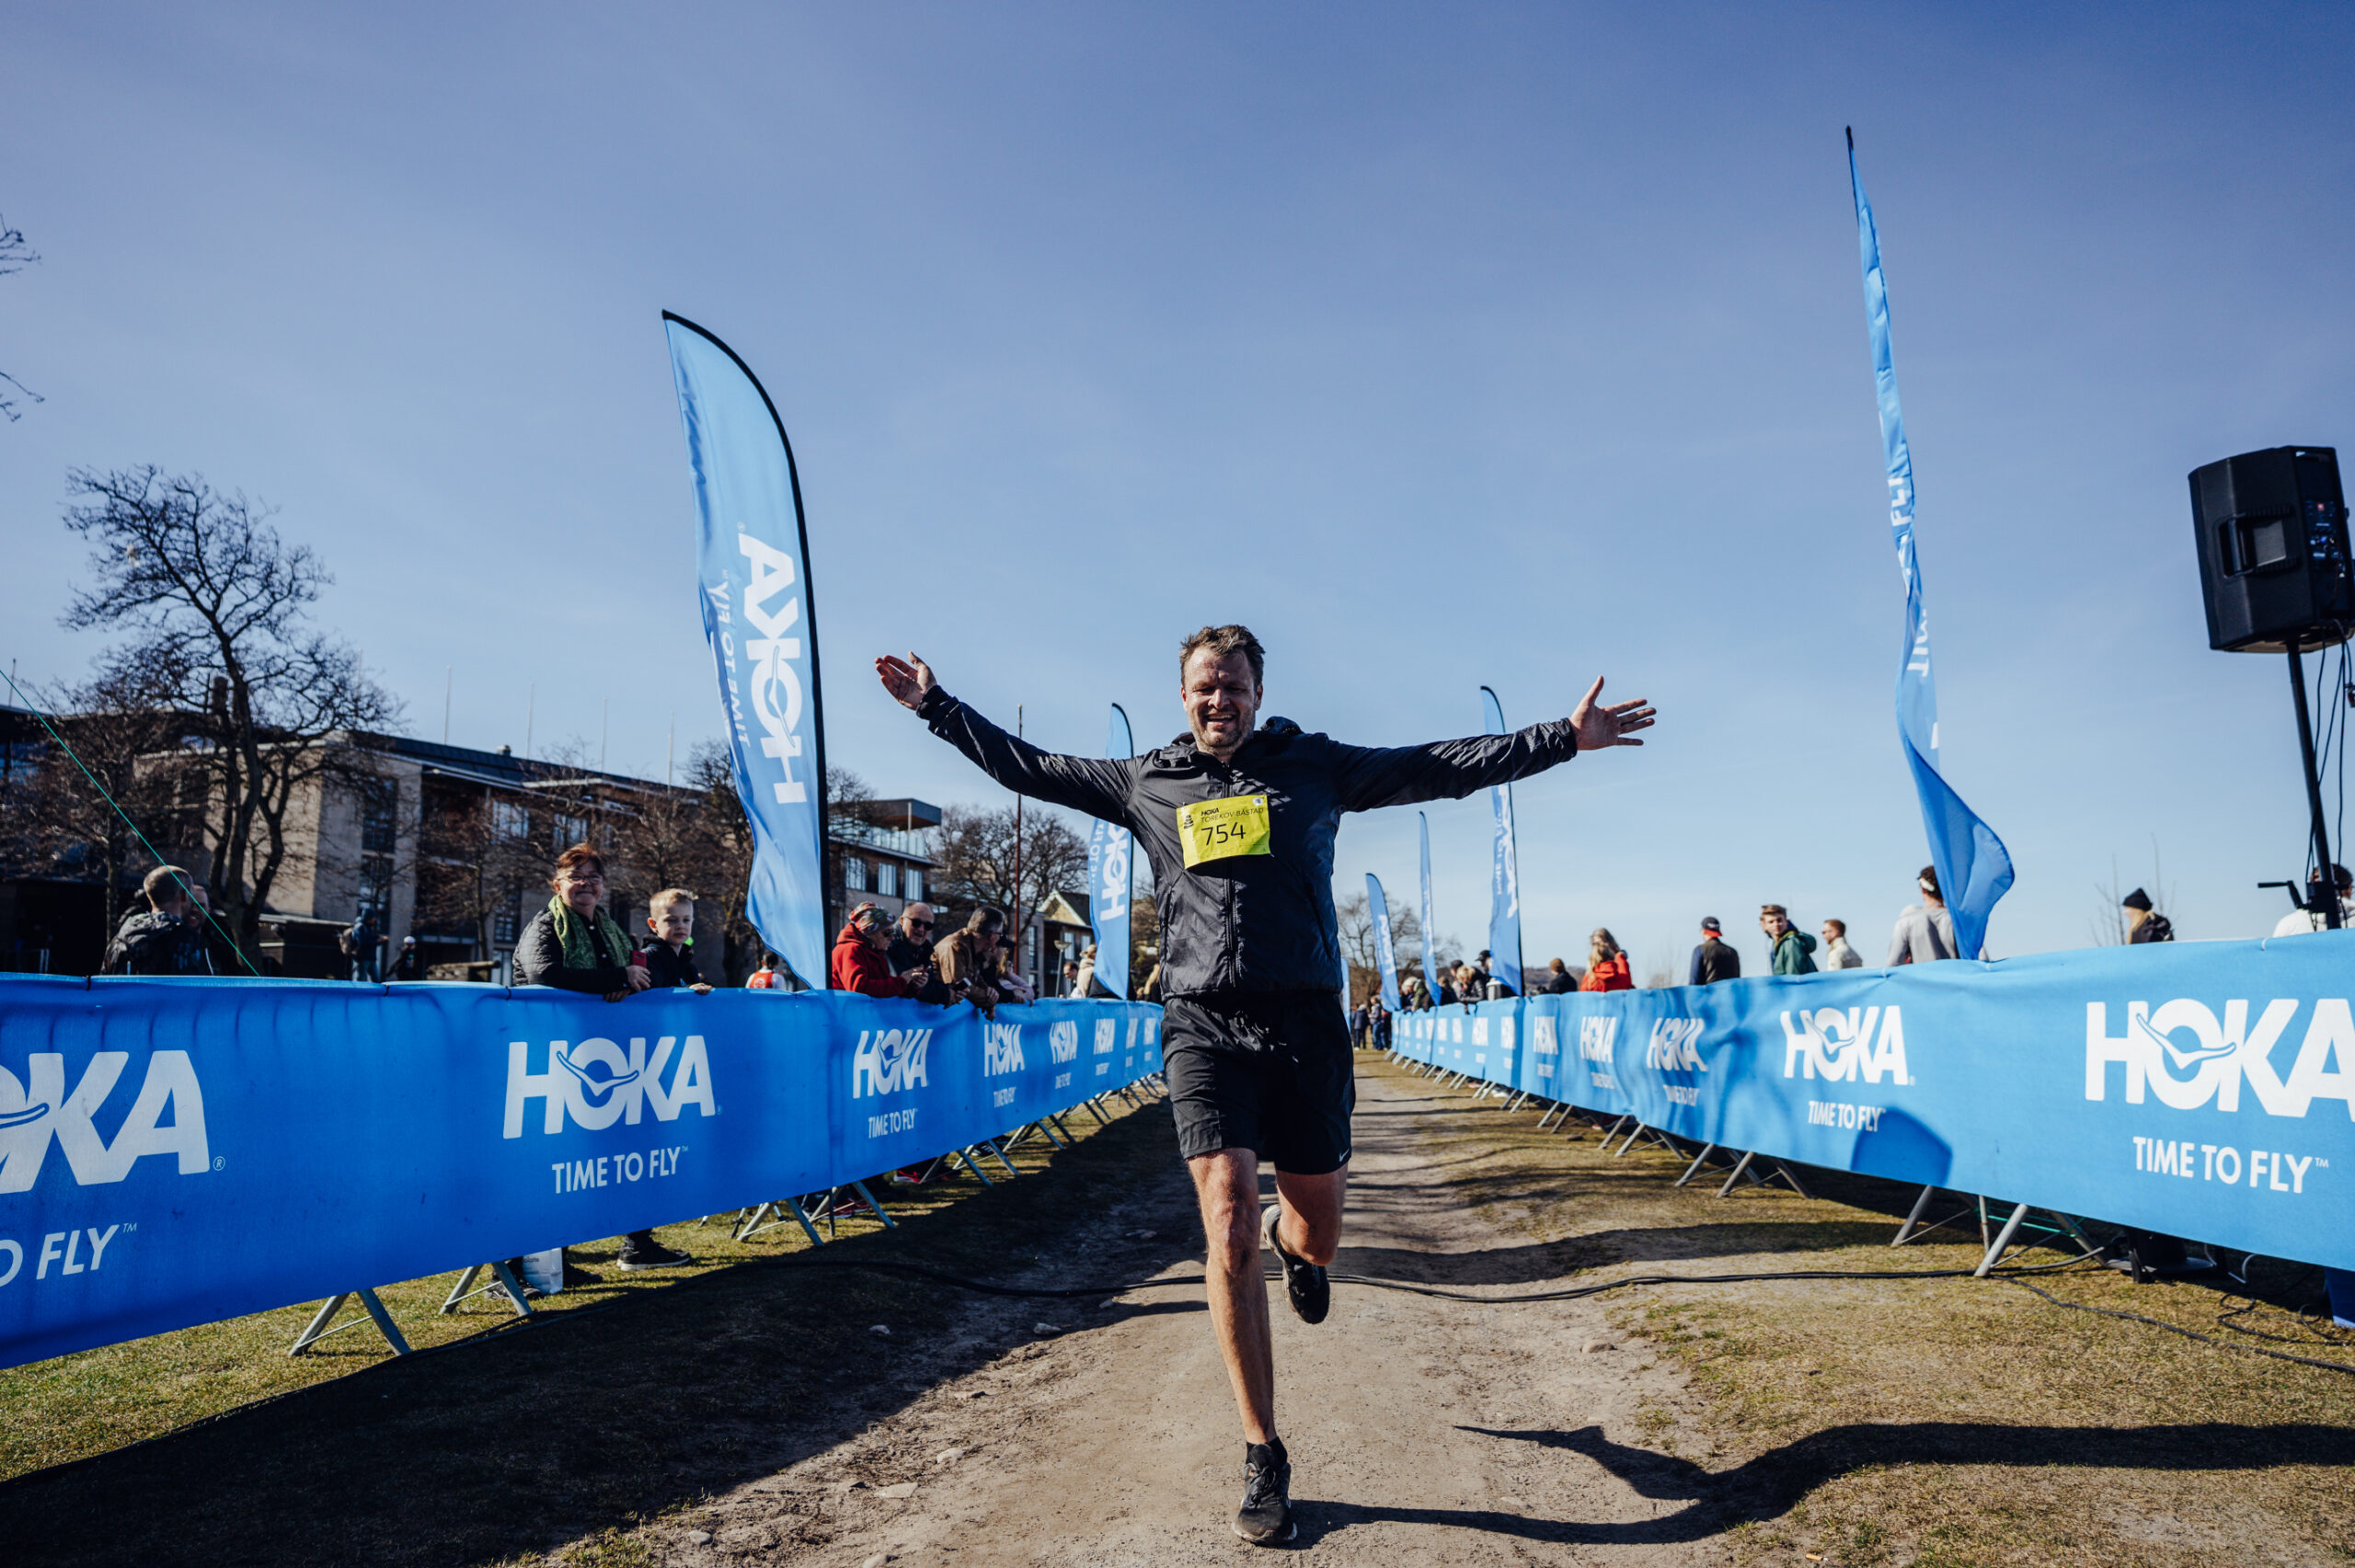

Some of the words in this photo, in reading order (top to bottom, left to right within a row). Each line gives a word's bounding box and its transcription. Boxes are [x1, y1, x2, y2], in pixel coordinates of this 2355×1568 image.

[1200, 811, 1234, 823] TOREKOV
[1235, 807, 1264, 818] BÅSTAD
[1200, 821, 1246, 846] 754
[1201, 807, 1220, 817] HOKA
[853, 1028, 933, 1099] HOKA
[983, 1023, 1025, 1077] HOKA
[1780, 1005, 1909, 1086] HOKA
[2085, 998, 2355, 1123] HOKA
[503, 1036, 716, 1139] HOKA
[868, 1114, 889, 1139] TIME
[890, 1111, 902, 1134] TO
[1809, 1100, 1835, 1127] TIME
[1837, 1104, 1855, 1129] TO
[1857, 1105, 1882, 1132] FLY
[552, 1162, 607, 1194] TIME
[614, 1152, 644, 1184] TO
[2132, 1136, 2195, 1178] TIME
[2200, 1144, 2242, 1185] TO
